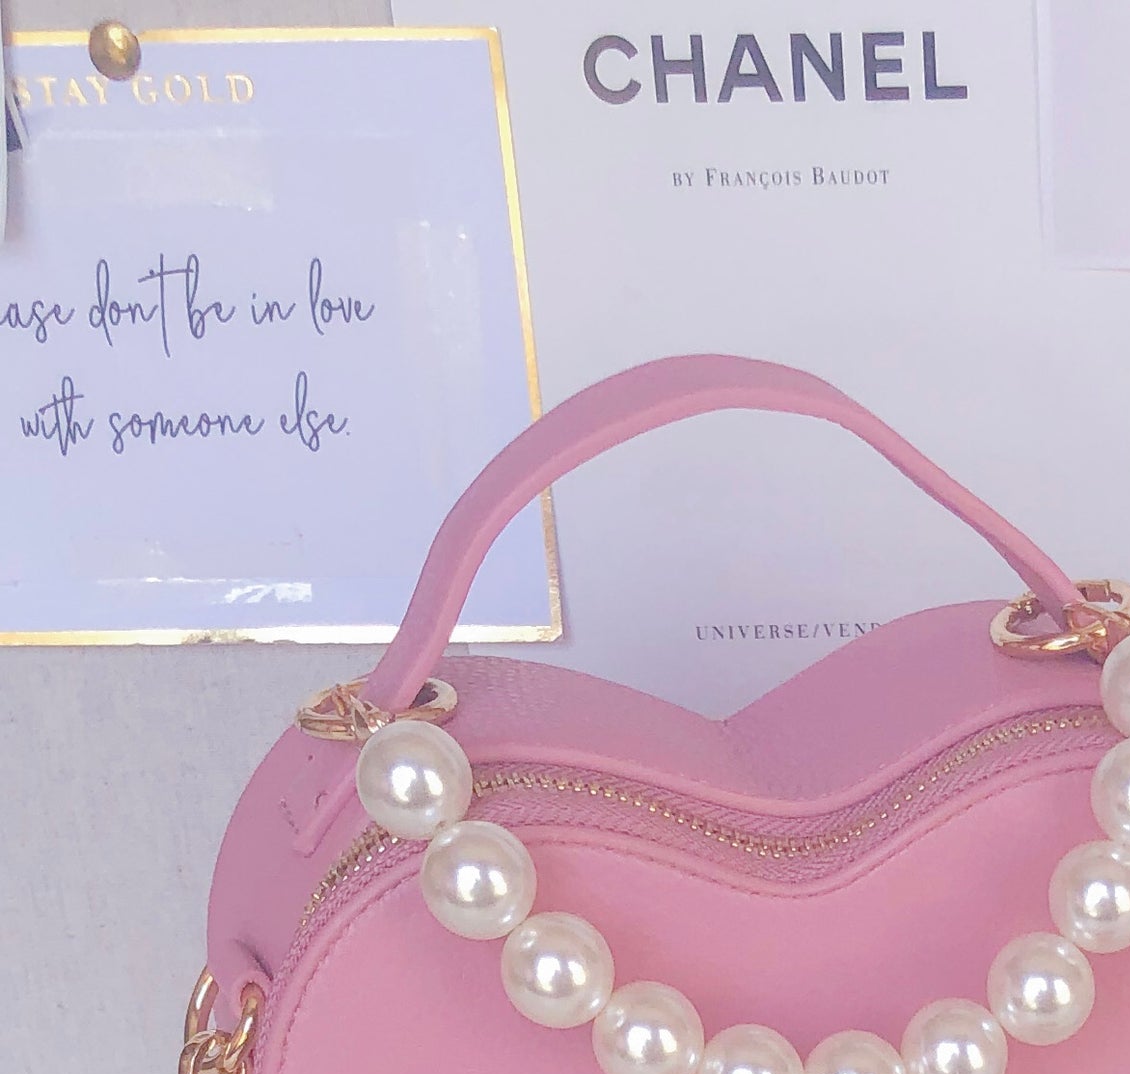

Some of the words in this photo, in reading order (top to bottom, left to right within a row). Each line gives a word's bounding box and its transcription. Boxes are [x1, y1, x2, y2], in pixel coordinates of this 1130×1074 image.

[15, 75, 109, 107] STAY
[132, 74, 255, 106] GOLD
[582, 31, 968, 105] CHANEL
[672, 172, 694, 187] BY
[706, 168, 801, 190] FRANÇOIS
[812, 166, 889, 185] BAUDOT
[0, 299, 76, 343] ase
[186, 253, 236, 339] be
[250, 293, 296, 326] in
[308, 257, 376, 336] love
[20, 376, 95, 457] with
[108, 410, 266, 455] someone
[280, 371, 351, 453] else.
